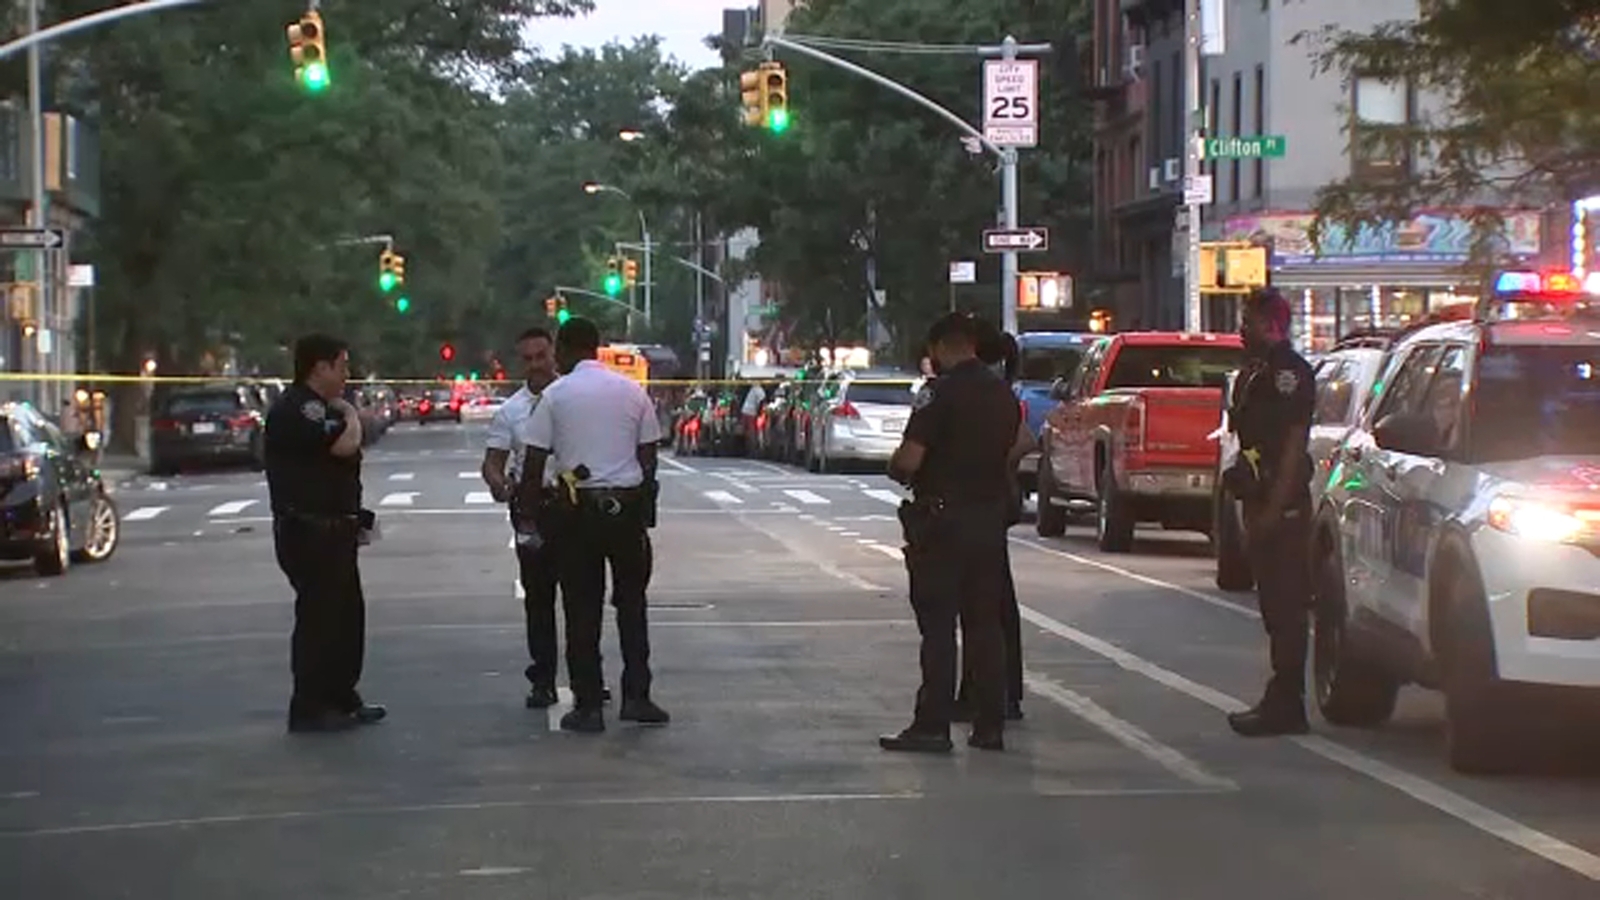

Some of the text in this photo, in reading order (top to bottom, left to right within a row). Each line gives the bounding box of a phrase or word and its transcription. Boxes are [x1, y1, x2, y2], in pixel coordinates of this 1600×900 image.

[994, 75, 1024, 84] SPEED
[991, 96, 1029, 119] 25
[1209, 137, 1261, 157] Clifton
